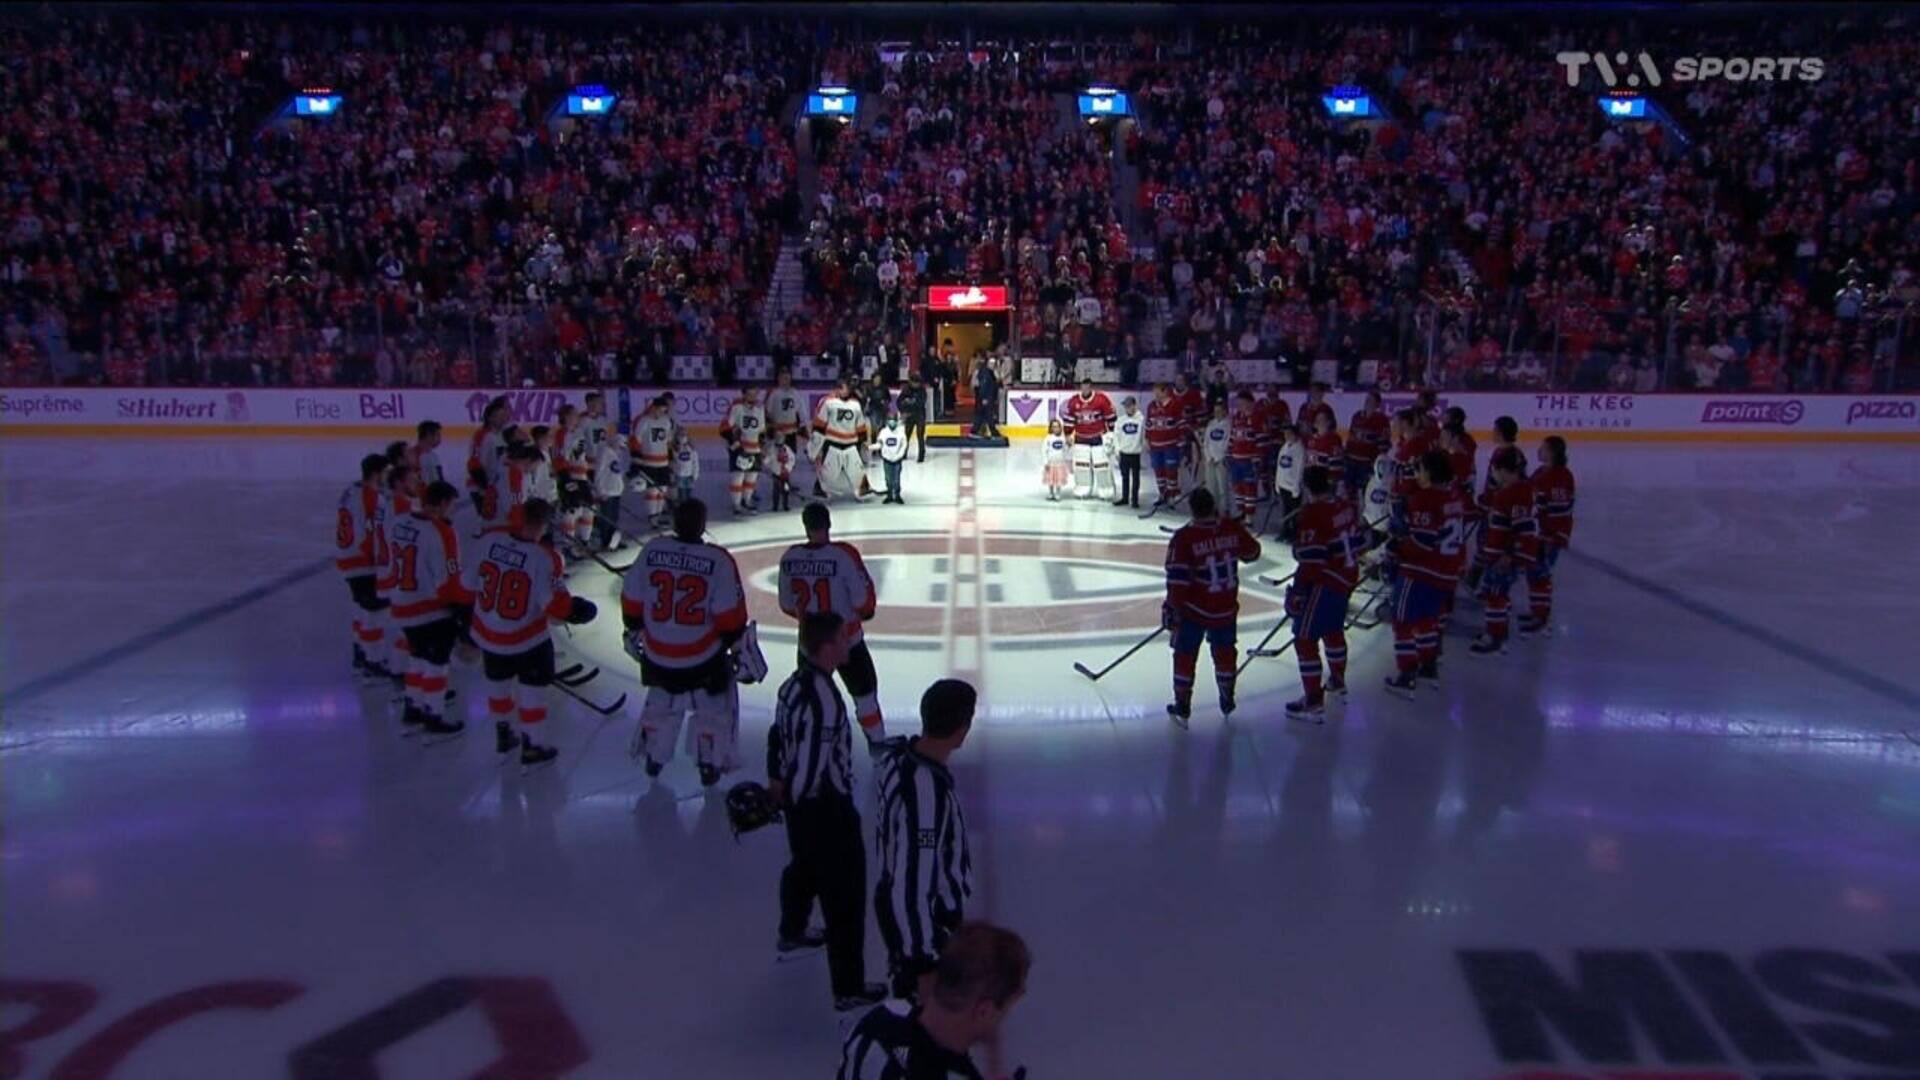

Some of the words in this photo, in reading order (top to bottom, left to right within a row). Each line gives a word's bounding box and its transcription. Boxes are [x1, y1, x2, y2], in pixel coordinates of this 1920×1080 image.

[296, 397, 341, 418] Fibe
[360, 394, 405, 419] Bell
[1535, 395, 1580, 411] THE
[1590, 395, 1634, 412] KEG
[1847, 401, 1915, 425] pizza
[1533, 416, 1583, 428] STEAK
[1205, 551, 1235, 594] 11
[479, 561, 531, 620] 38
[650, 569, 708, 625] 32
[1454, 947, 1920, 1068] MIS
